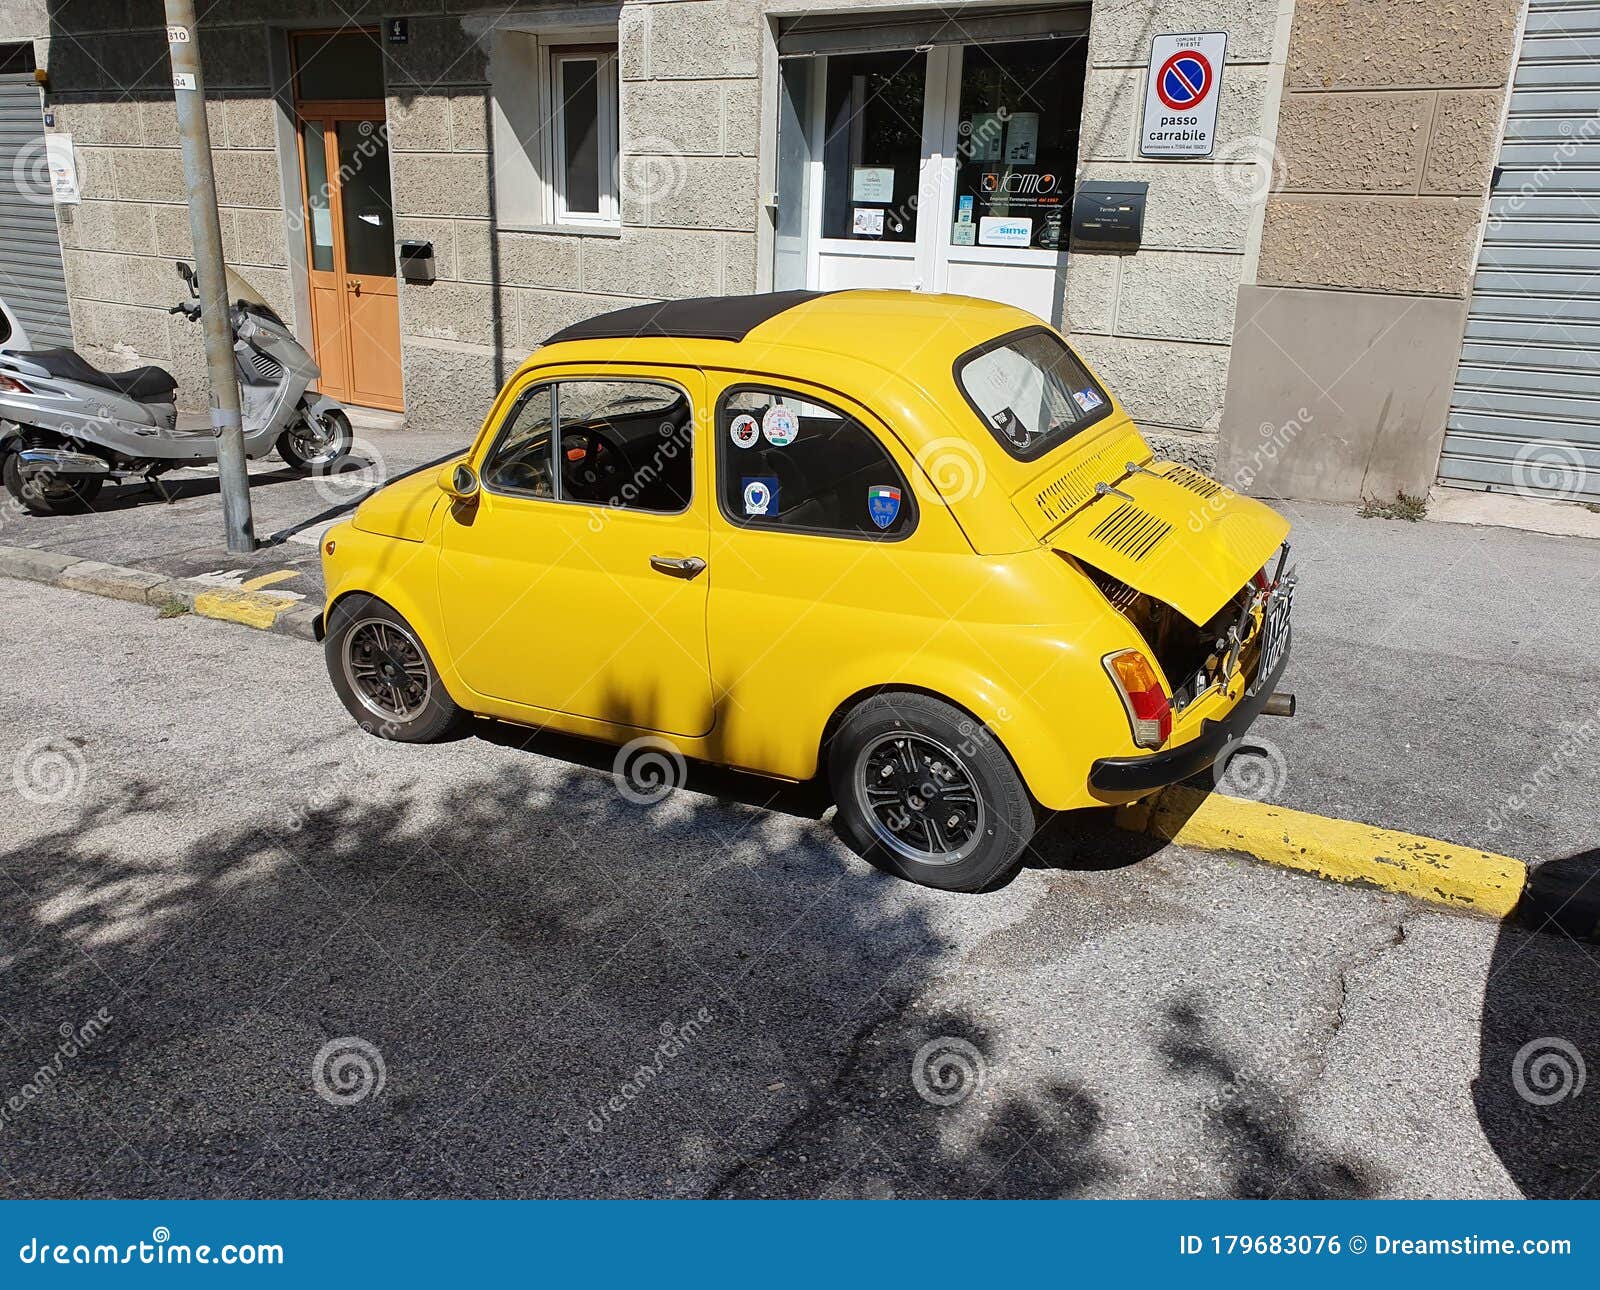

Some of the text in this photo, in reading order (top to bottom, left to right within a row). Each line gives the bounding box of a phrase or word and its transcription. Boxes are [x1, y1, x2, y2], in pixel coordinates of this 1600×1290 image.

[173, 78, 187, 88] 04
[1160, 116, 1198, 128] passo
[1149, 129, 1206, 141] carrabile
[999, 170, 1056, 194] termo
[999, 225, 1029, 236] sime
